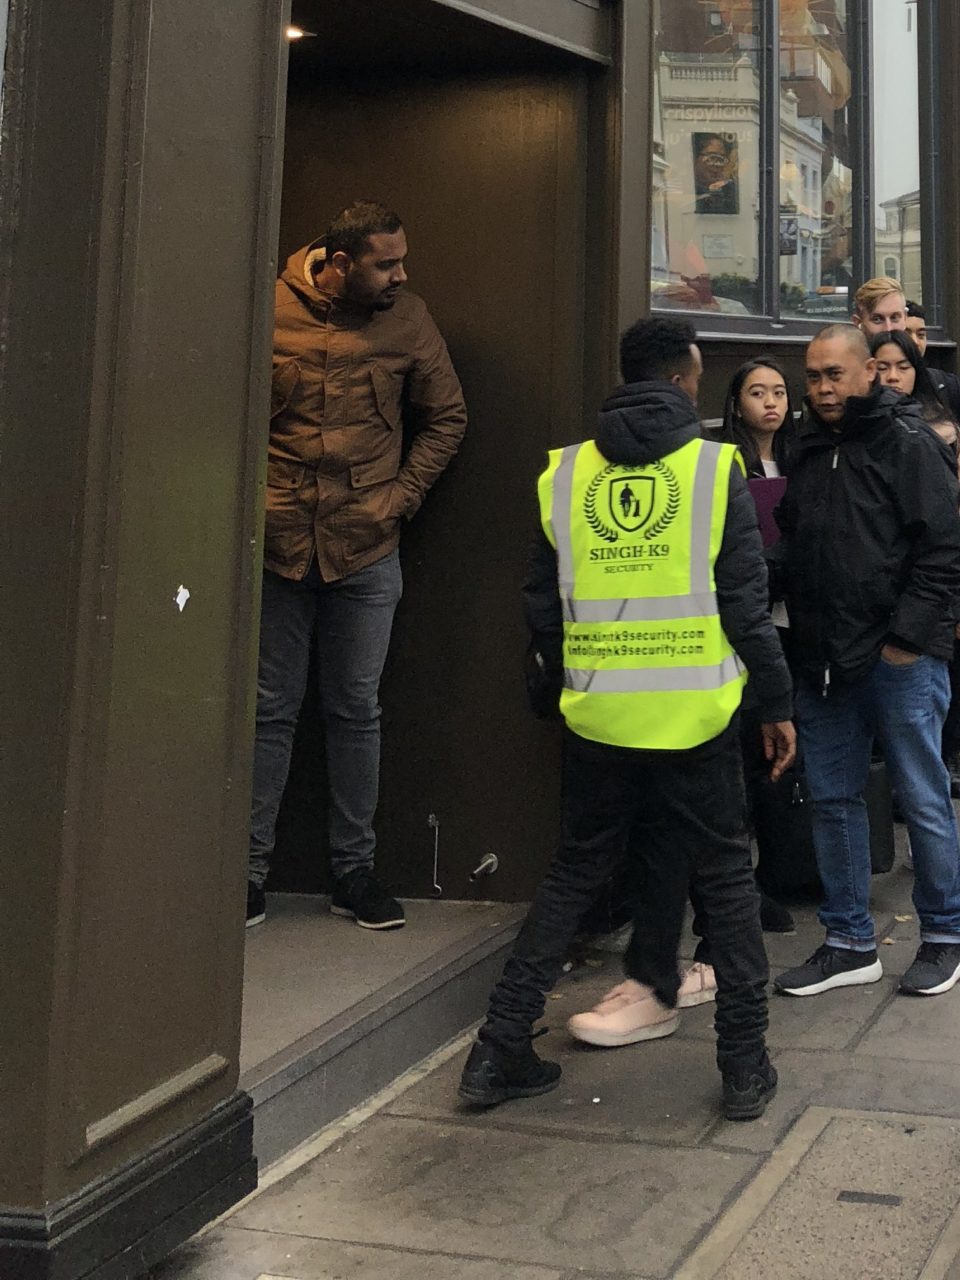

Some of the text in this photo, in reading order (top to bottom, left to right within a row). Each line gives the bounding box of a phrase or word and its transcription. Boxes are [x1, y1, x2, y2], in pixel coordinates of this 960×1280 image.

[664, 103, 753, 123] crispylicio
[590, 544, 670, 561] SINGH-K9
[604, 563, 654, 574] SECURITY
